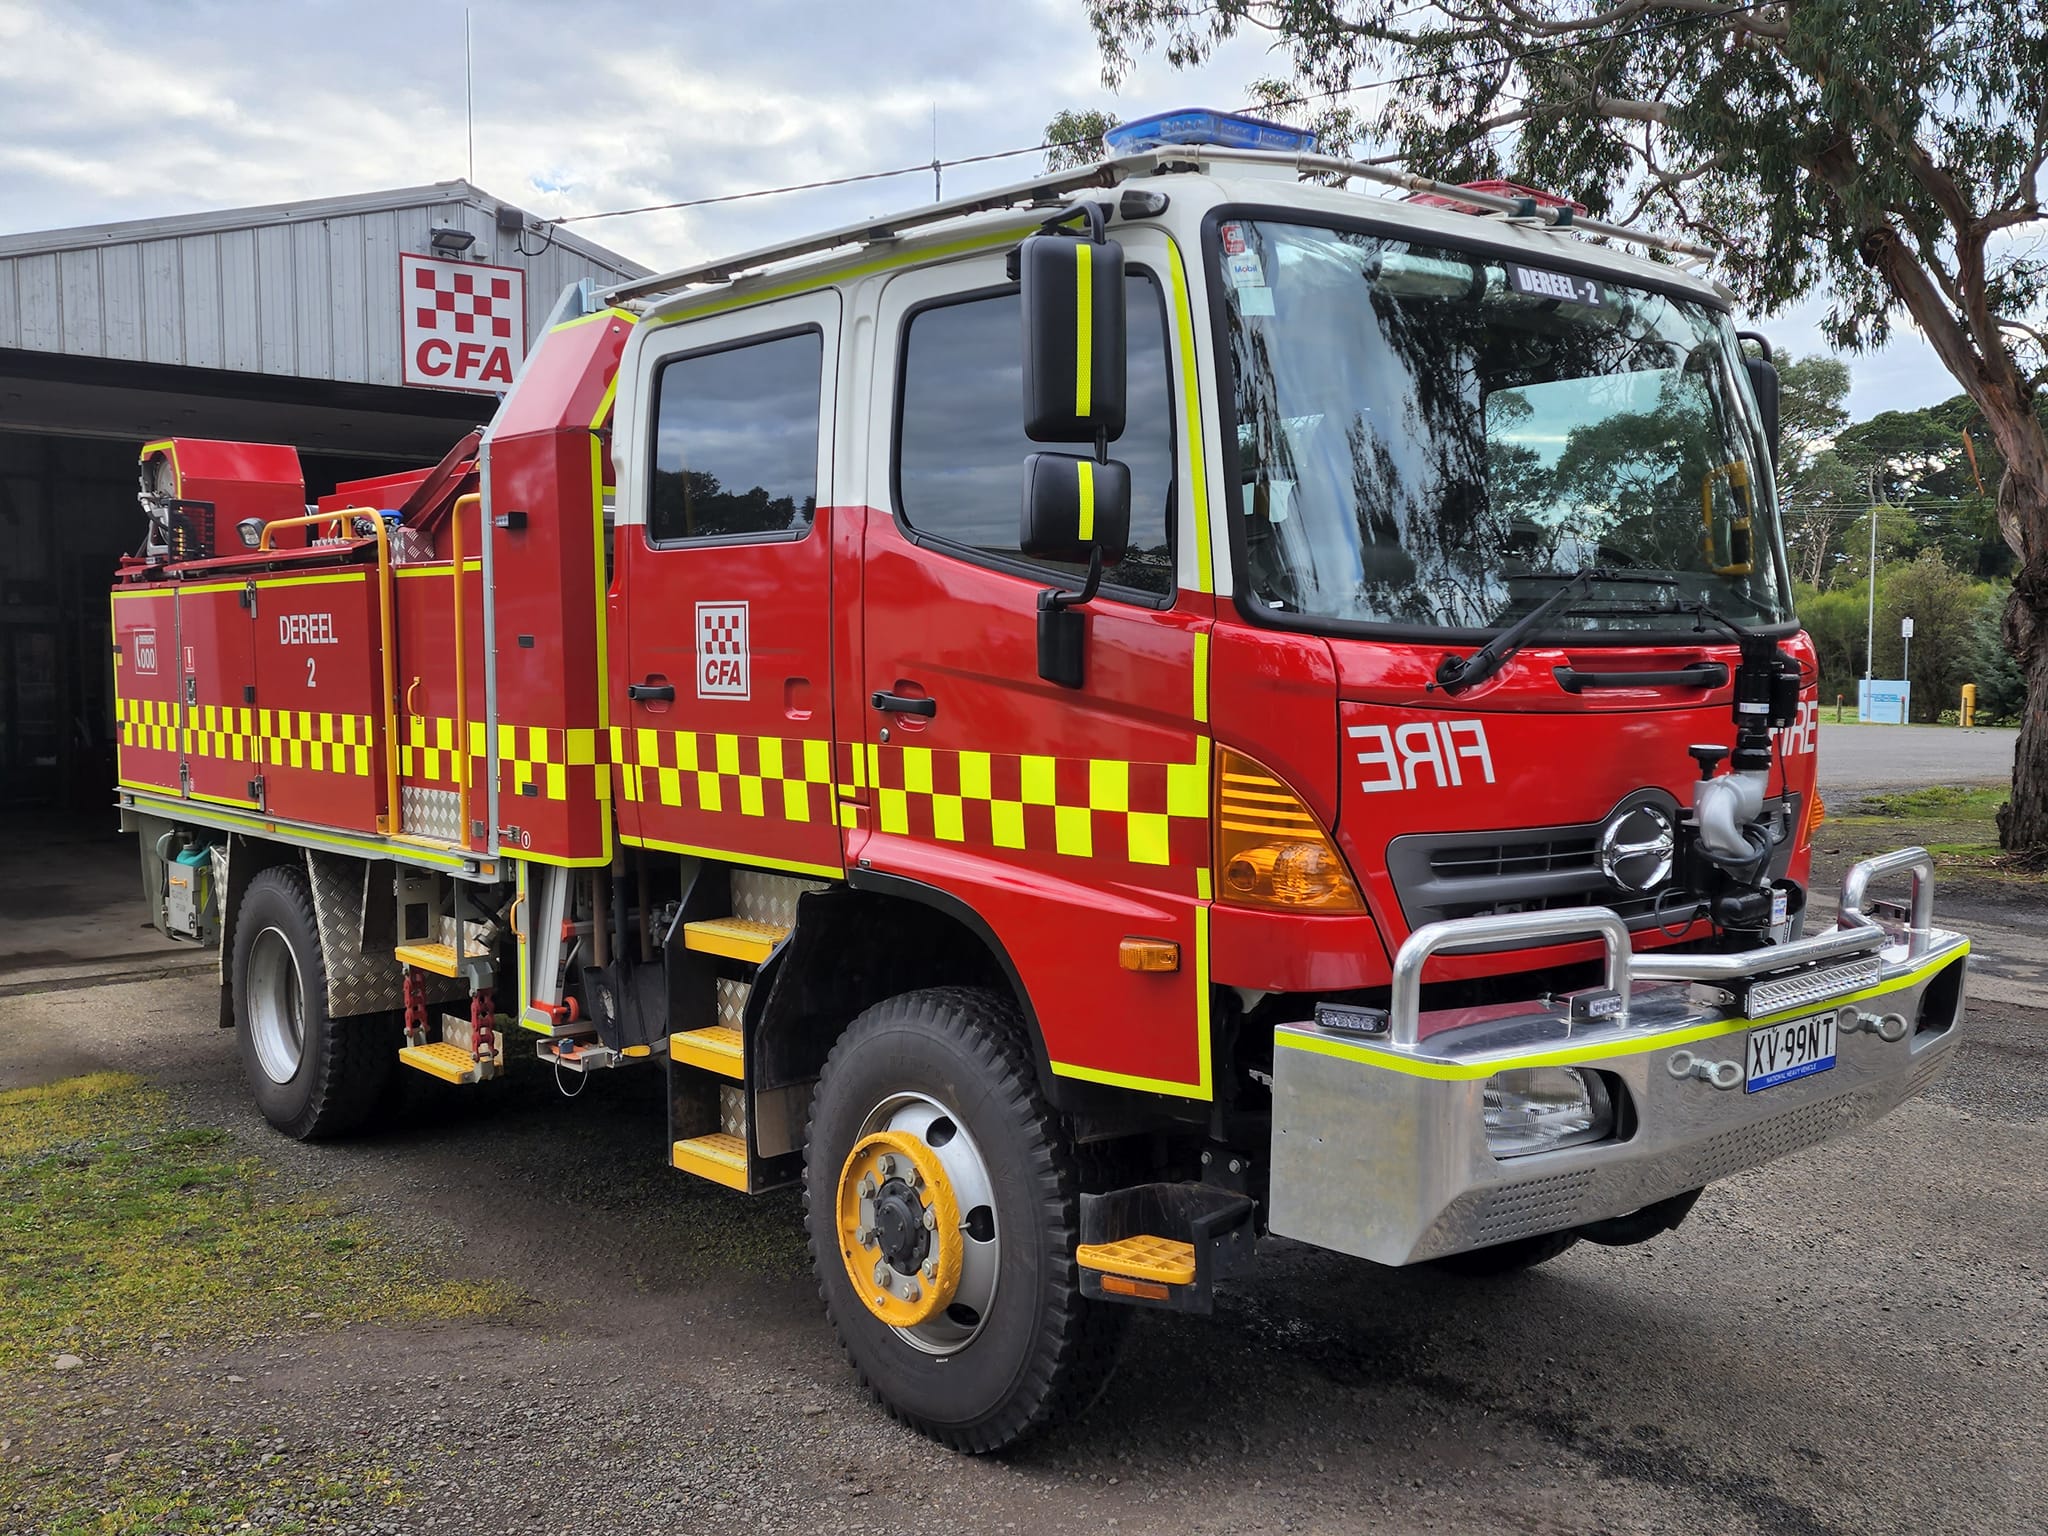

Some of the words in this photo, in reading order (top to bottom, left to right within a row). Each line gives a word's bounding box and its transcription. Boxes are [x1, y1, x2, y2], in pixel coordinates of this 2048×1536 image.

[1235, 265, 1257, 273] Mobil
[416, 338, 513, 383] CFA
[280, 613, 338, 644] DEREEL
[141, 648, 155, 669] 000
[307, 657, 316, 687] 2
[705, 659, 741, 685] CFA
